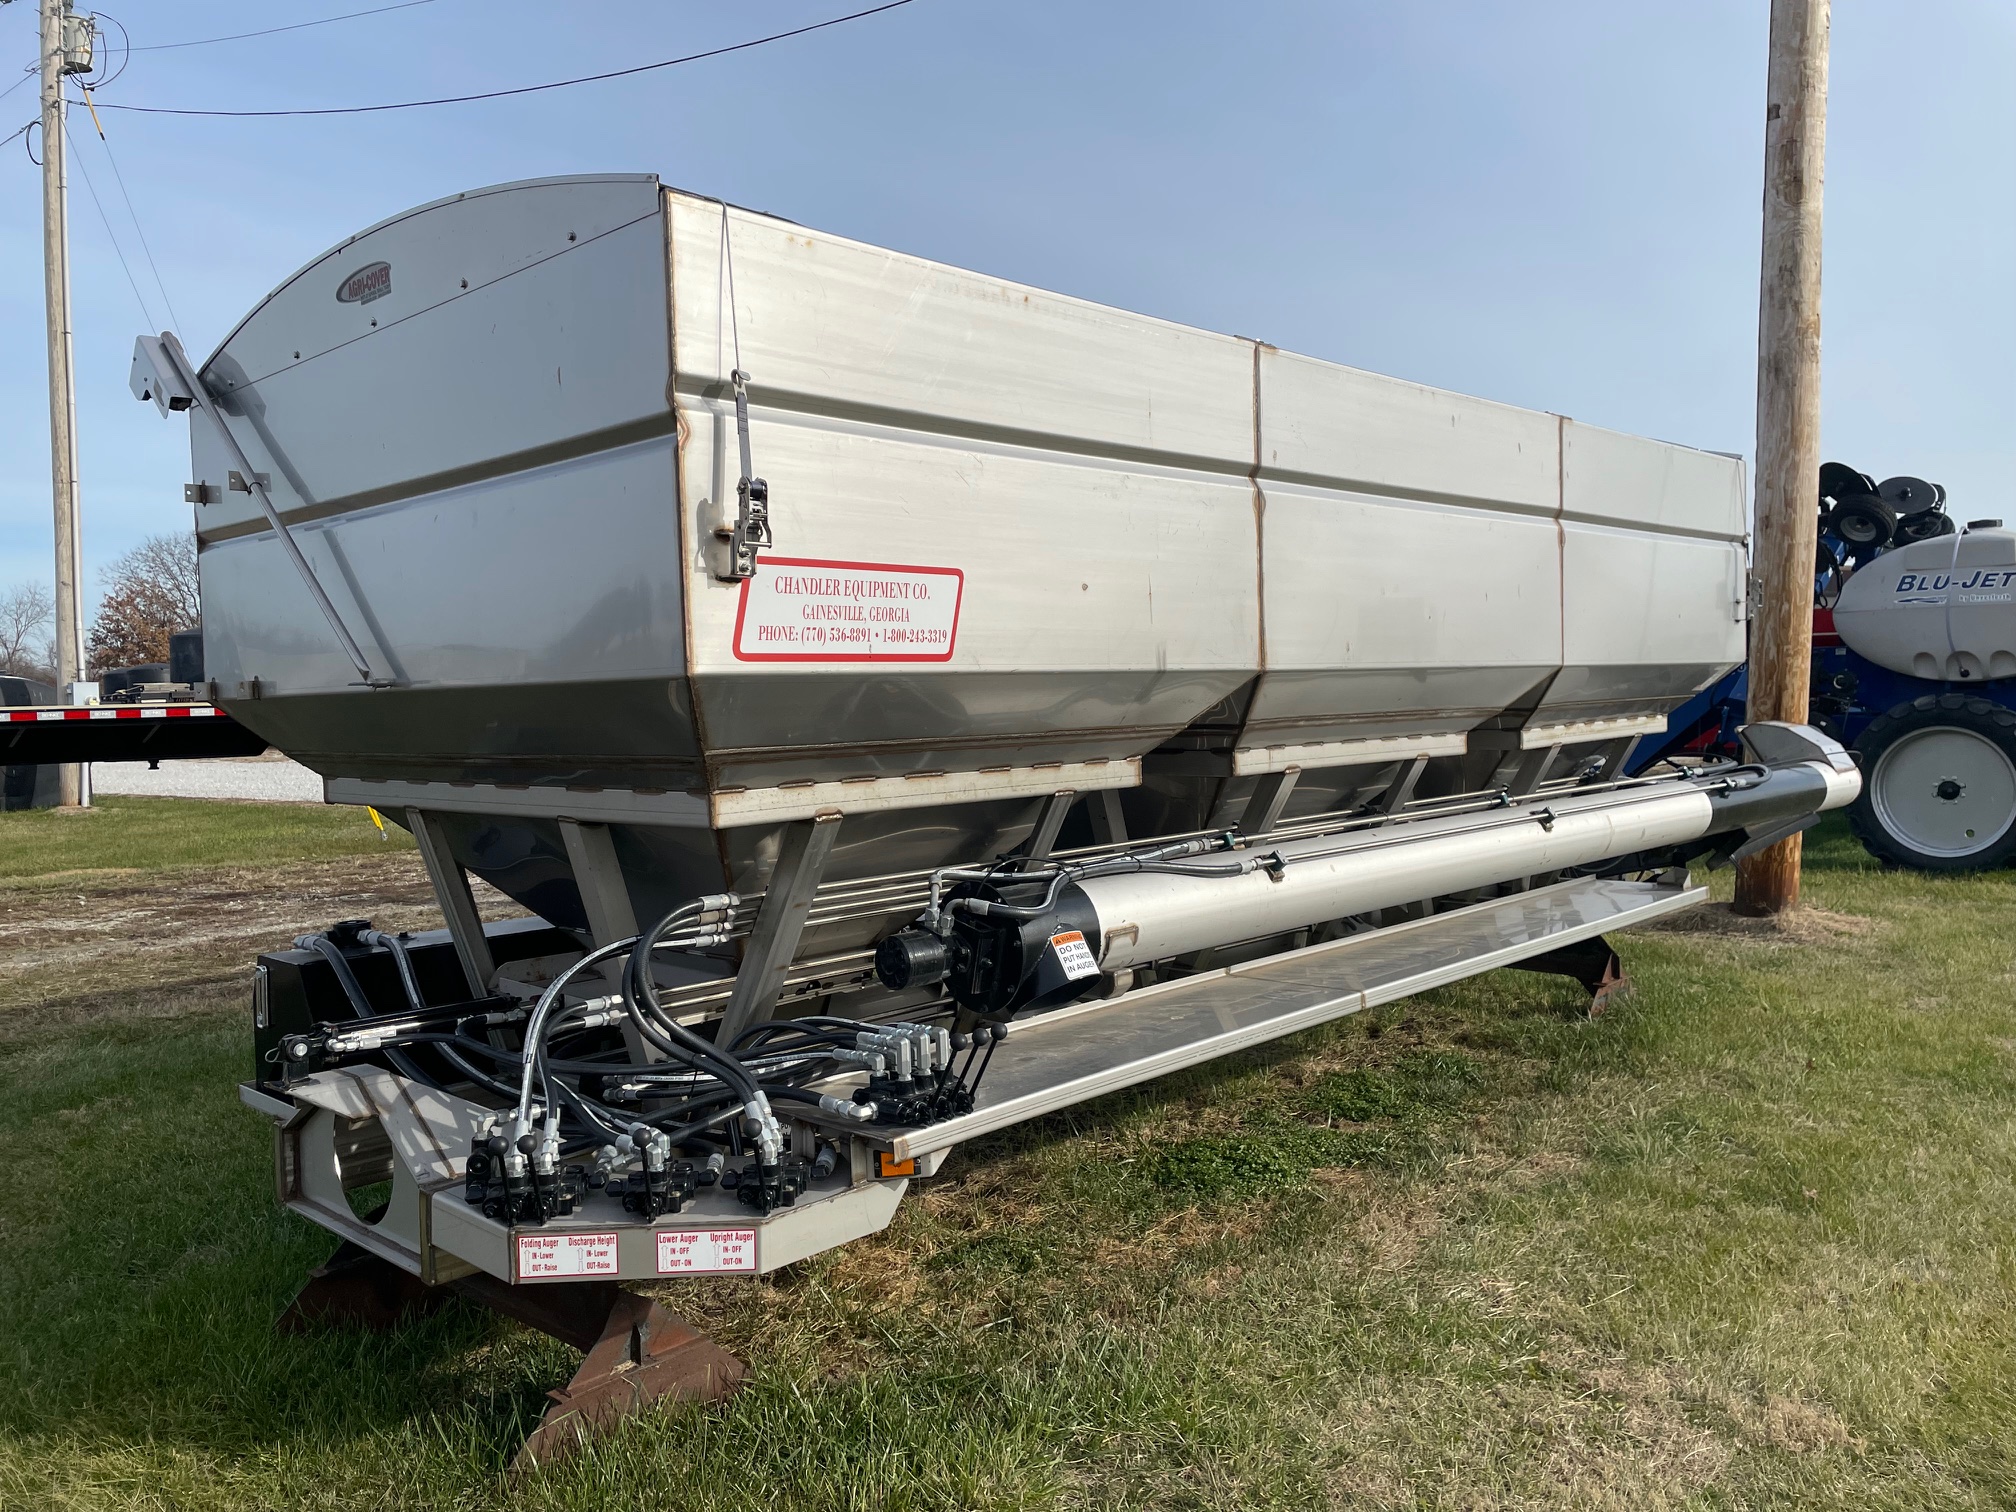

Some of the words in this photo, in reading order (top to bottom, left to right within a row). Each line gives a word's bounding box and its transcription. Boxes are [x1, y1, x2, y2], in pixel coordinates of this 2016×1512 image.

[775, 576, 841, 597] CHANDLER
[843, 579, 911, 601] EQUIPMENT
[913, 583, 931, 600] CO.
[802, 604, 867, 624] GAINESVILLE,
[869, 606, 910, 623] GEORGIA
[758, 625, 799, 642] PHONE:
[801, 626, 827, 646] (770)
[829, 628, 872, 643] 536-8891
[883, 629, 947, 643] 1-800-243-3319
[1059, 945, 1072, 954] DO
[1073, 943, 1086, 951] NOT
[1063, 954, 1077, 964] PUT
[1067, 965, 1076, 973] IN
[521, 1239, 541, 1249] Folding
[542, 1238, 559, 1248] Auger
[568, 1237, 596, 1247] Discharge
[597, 1236, 615, 1246] Height
[659, 1234, 678, 1244] Lower
[680, 1234, 698, 1244] Auger
[710, 1233, 733, 1244] Upright
[735, 1232, 753, 1243] Auger
